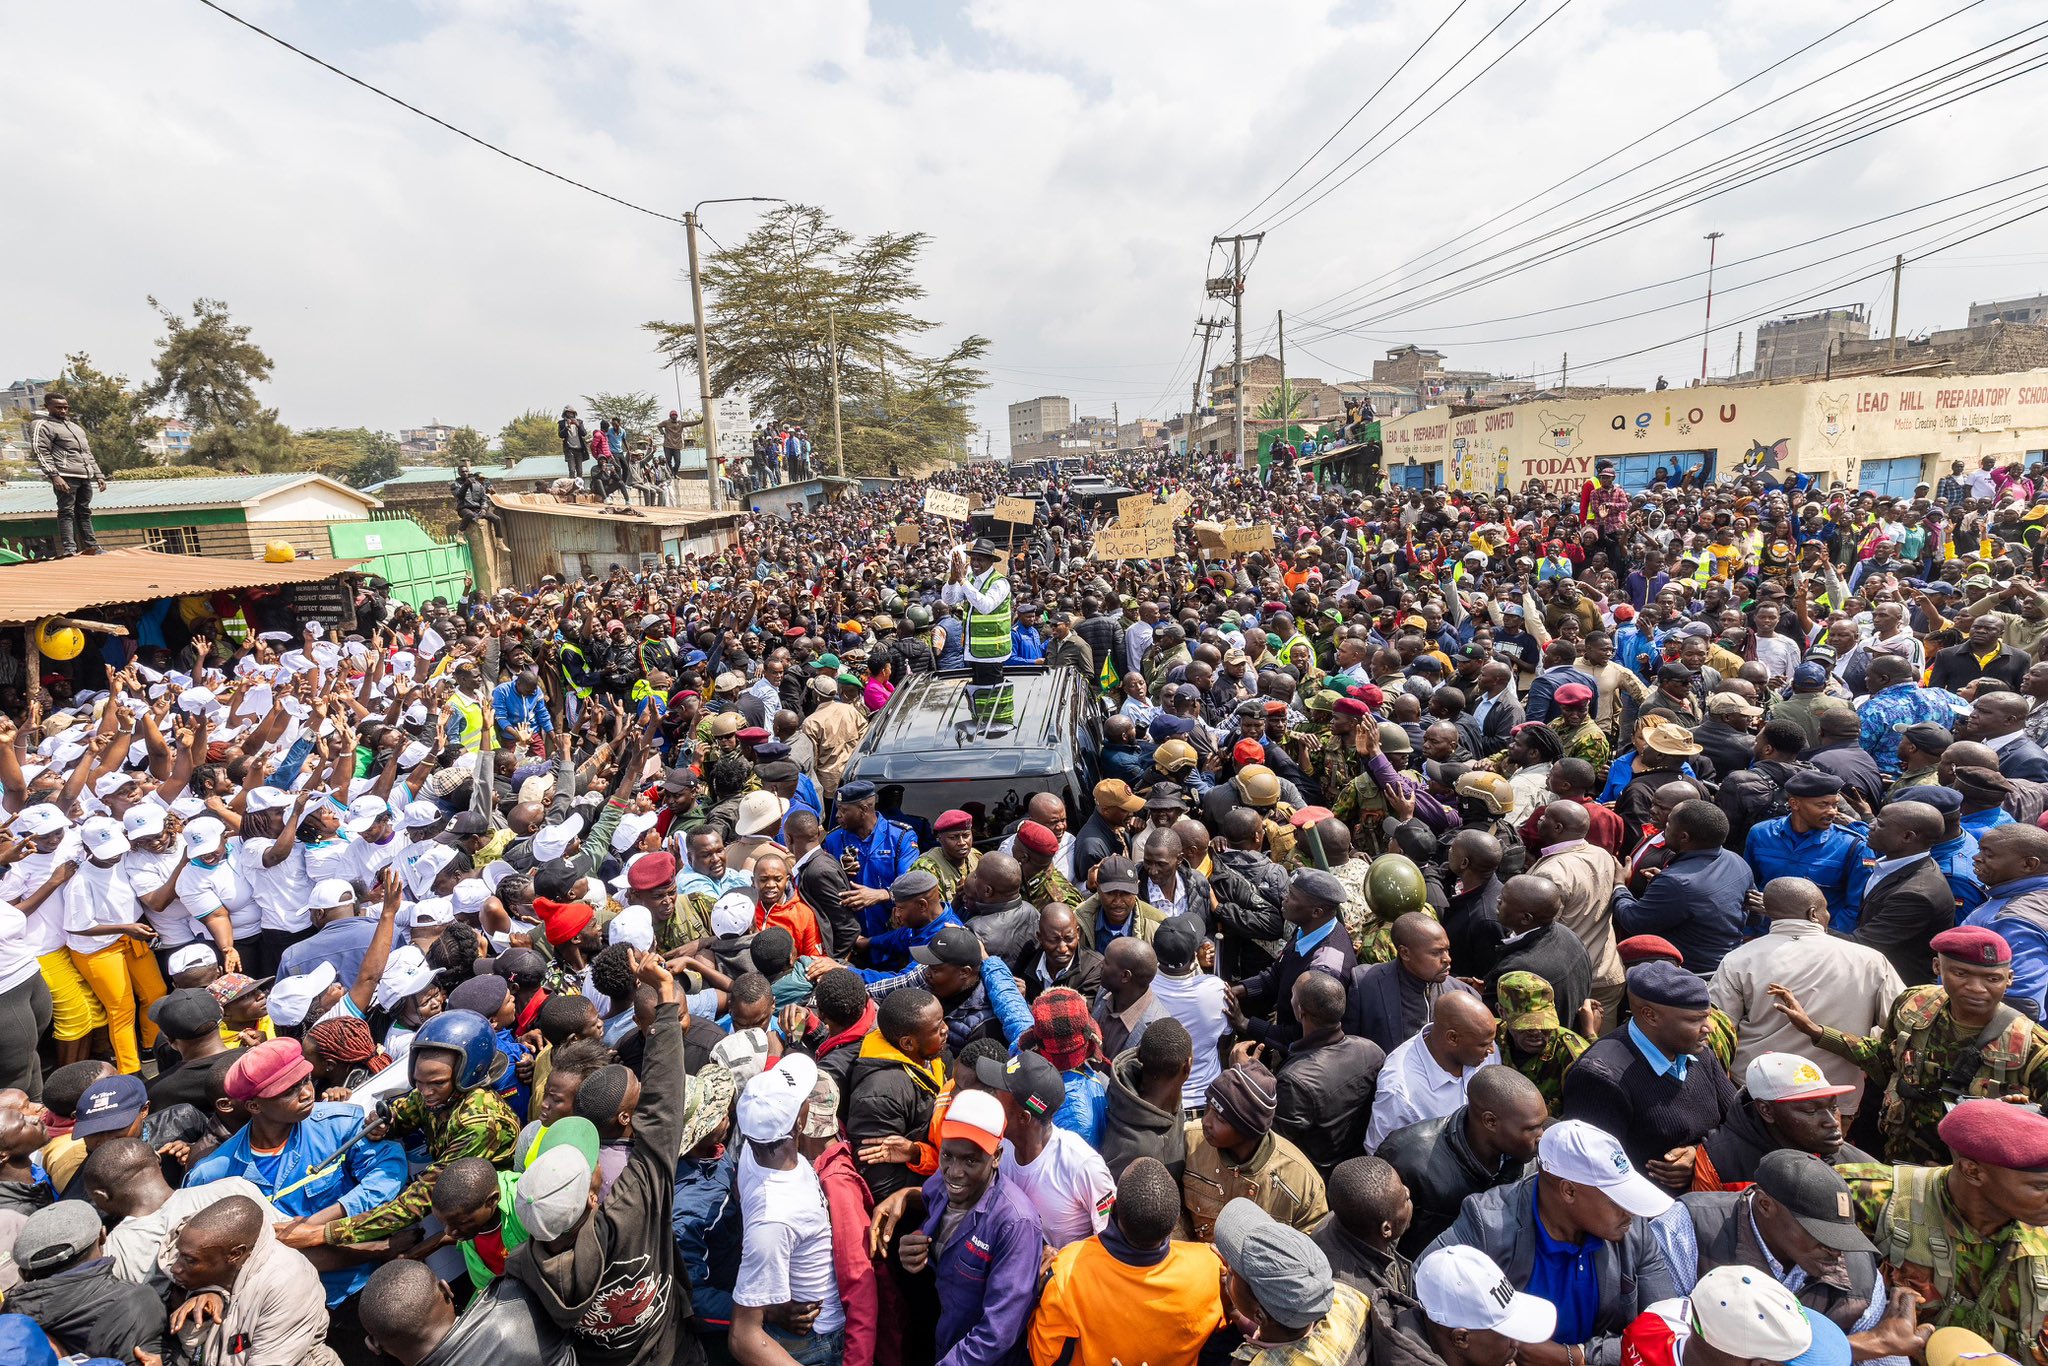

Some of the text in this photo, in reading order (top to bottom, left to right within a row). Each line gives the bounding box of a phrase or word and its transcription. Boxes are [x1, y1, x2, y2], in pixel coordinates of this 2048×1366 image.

[1856, 392, 1889, 413] LEAD
[1900, 391, 1924, 411] HILL
[1935, 388, 2011, 409] PREPARATORY
[1386, 411, 1514, 443] LEAD HILL PREPARATORY SCHOOL SOWETO
[1611, 414, 1626, 430] a
[1635, 412, 1652, 428] e
[1664, 406, 1671, 426] i
[1522, 456, 1592, 476] TODAY
[997, 495, 1021, 506] RUTO
[1105, 541, 1142, 556] RUTO
